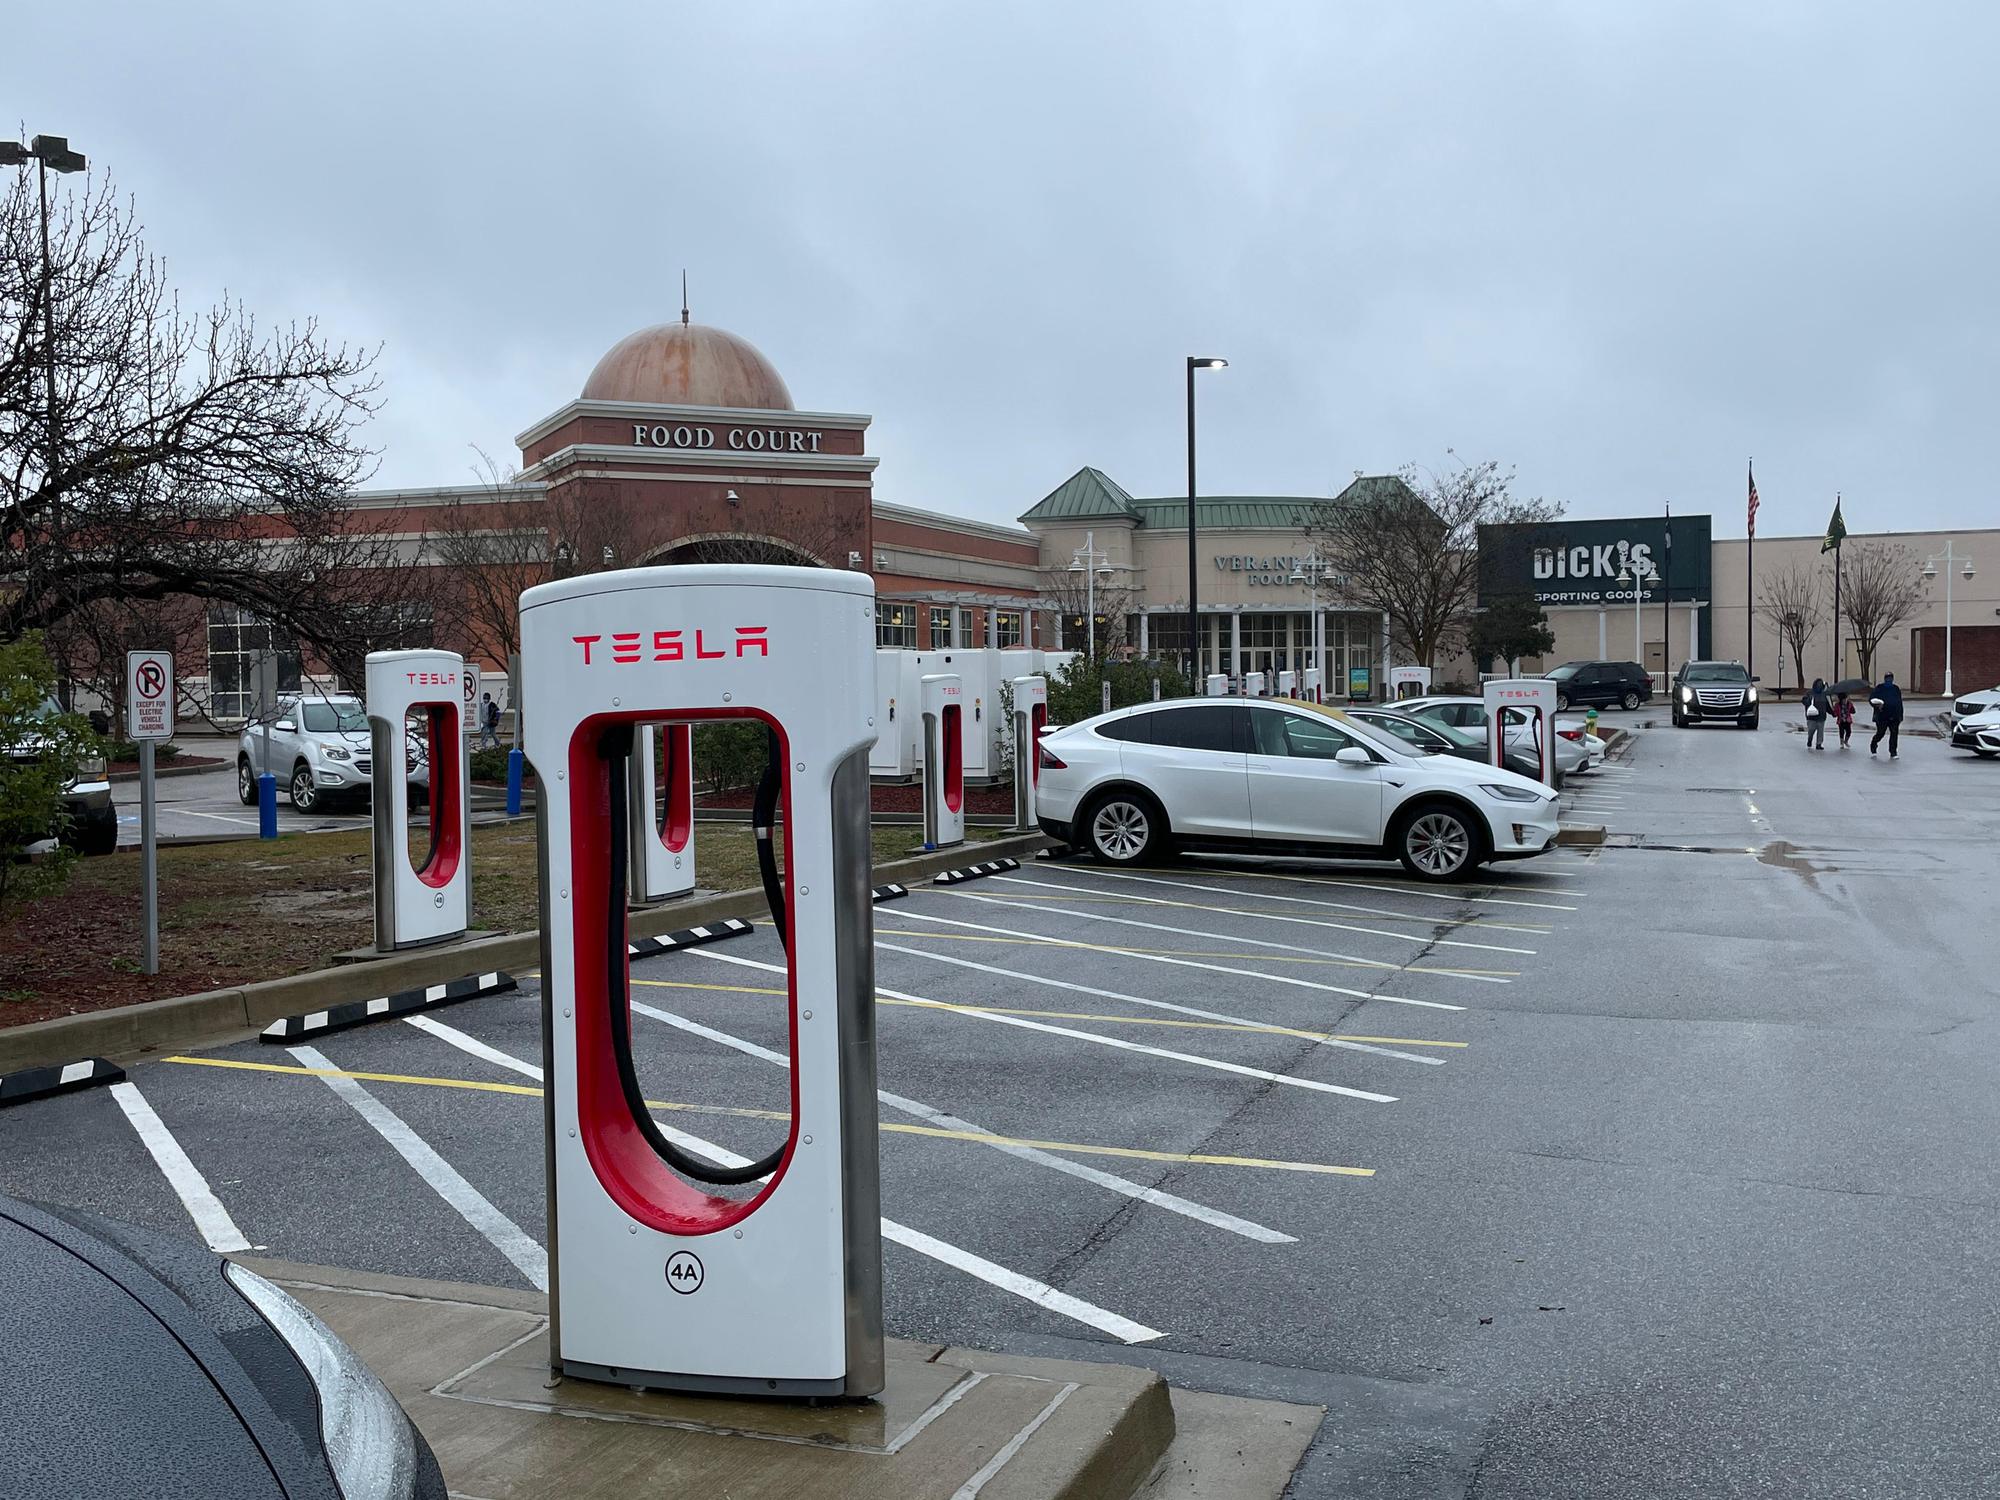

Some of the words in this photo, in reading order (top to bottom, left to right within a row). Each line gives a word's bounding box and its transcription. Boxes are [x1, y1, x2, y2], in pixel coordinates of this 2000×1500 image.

[633, 424, 715, 448] FOOD
[728, 429, 823, 452] COURT
[1534, 592, 1600, 602] SPORTING
[1605, 590, 1652, 600] GOODS
[572, 626, 768, 665] TESLA
[406, 673, 456, 685] TESLA
[1498, 690, 1540, 698] TESLA
[139, 708, 163, 716] ELECTRIC
[138, 723, 165, 731] CHARGING
[671, 1263, 698, 1280] 4A
